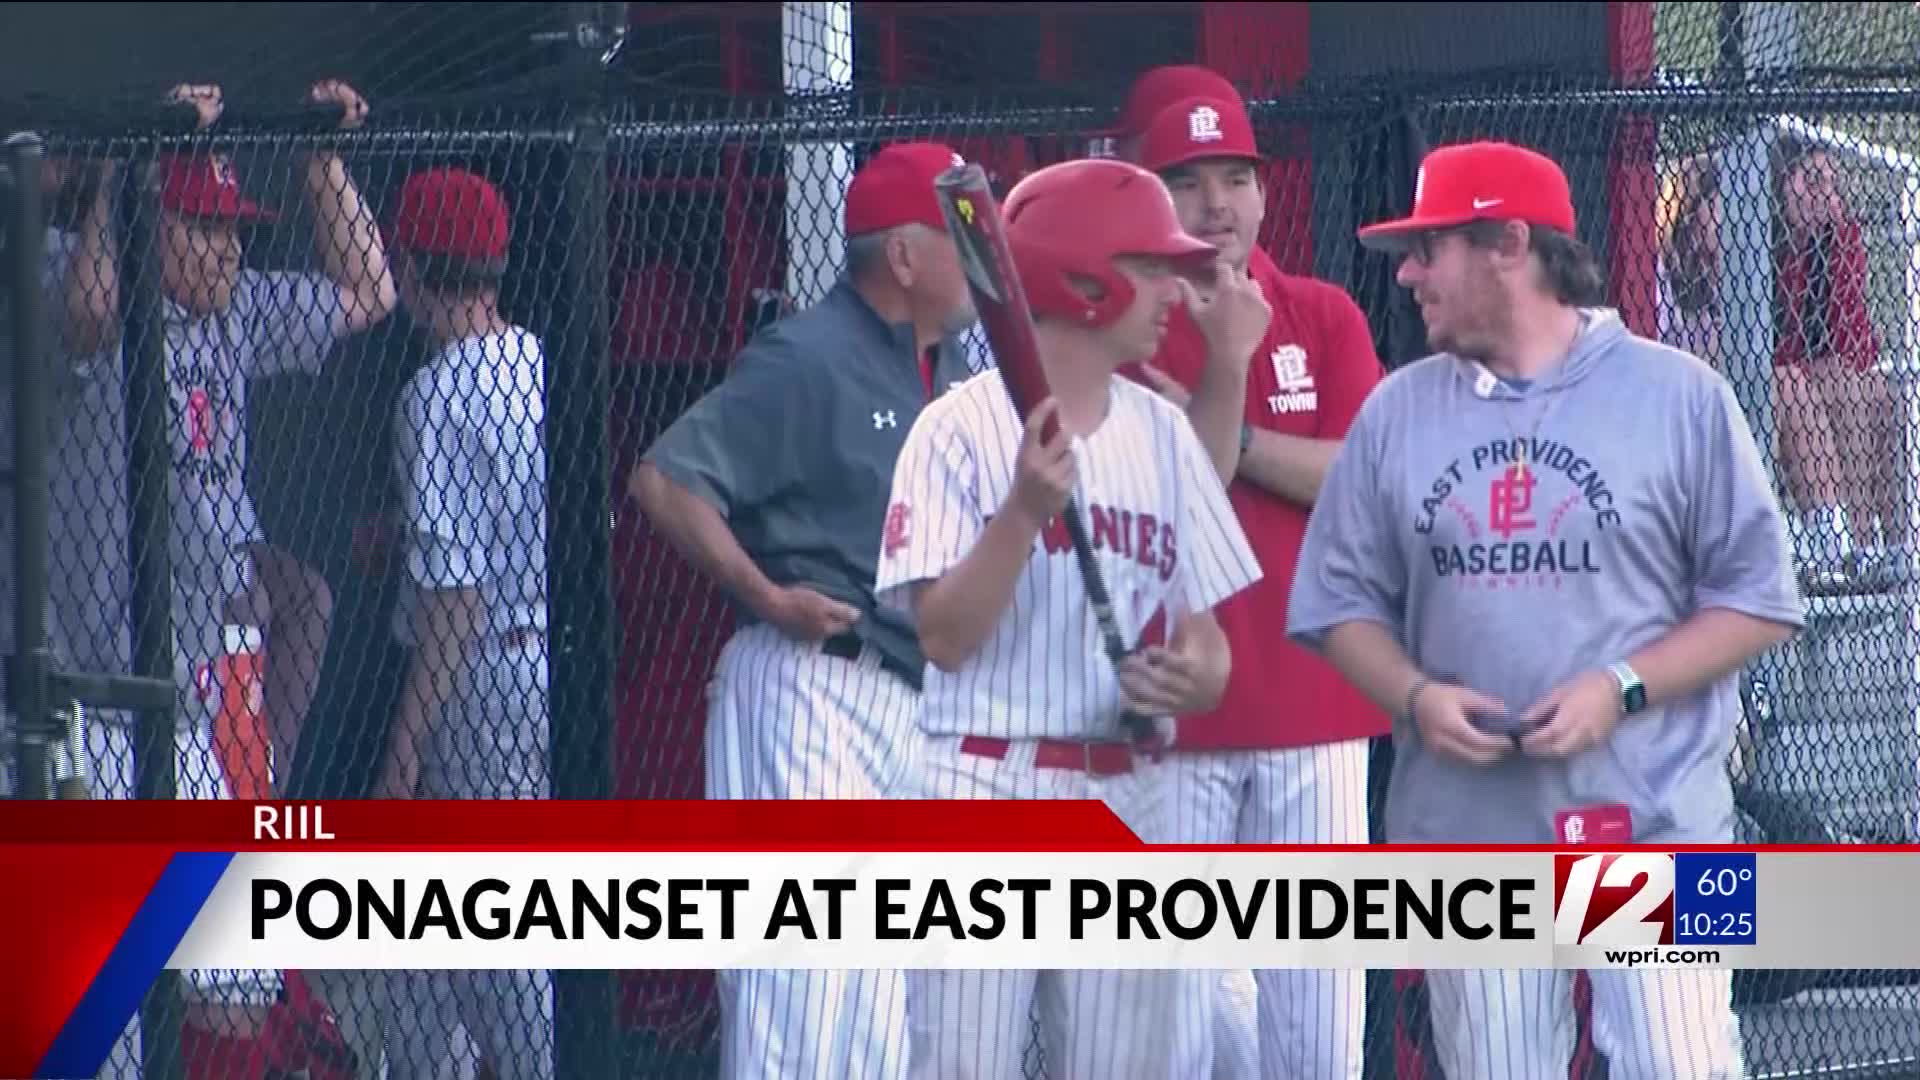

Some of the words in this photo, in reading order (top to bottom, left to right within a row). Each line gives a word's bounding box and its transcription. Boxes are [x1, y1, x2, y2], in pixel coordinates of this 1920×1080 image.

[1414, 459, 1463, 536] EAST
[1472, 436, 1621, 532] PROVIDENCE
[984, 502, 1178, 583] WNIES
[1431, 540, 1601, 577] BASEBALL
